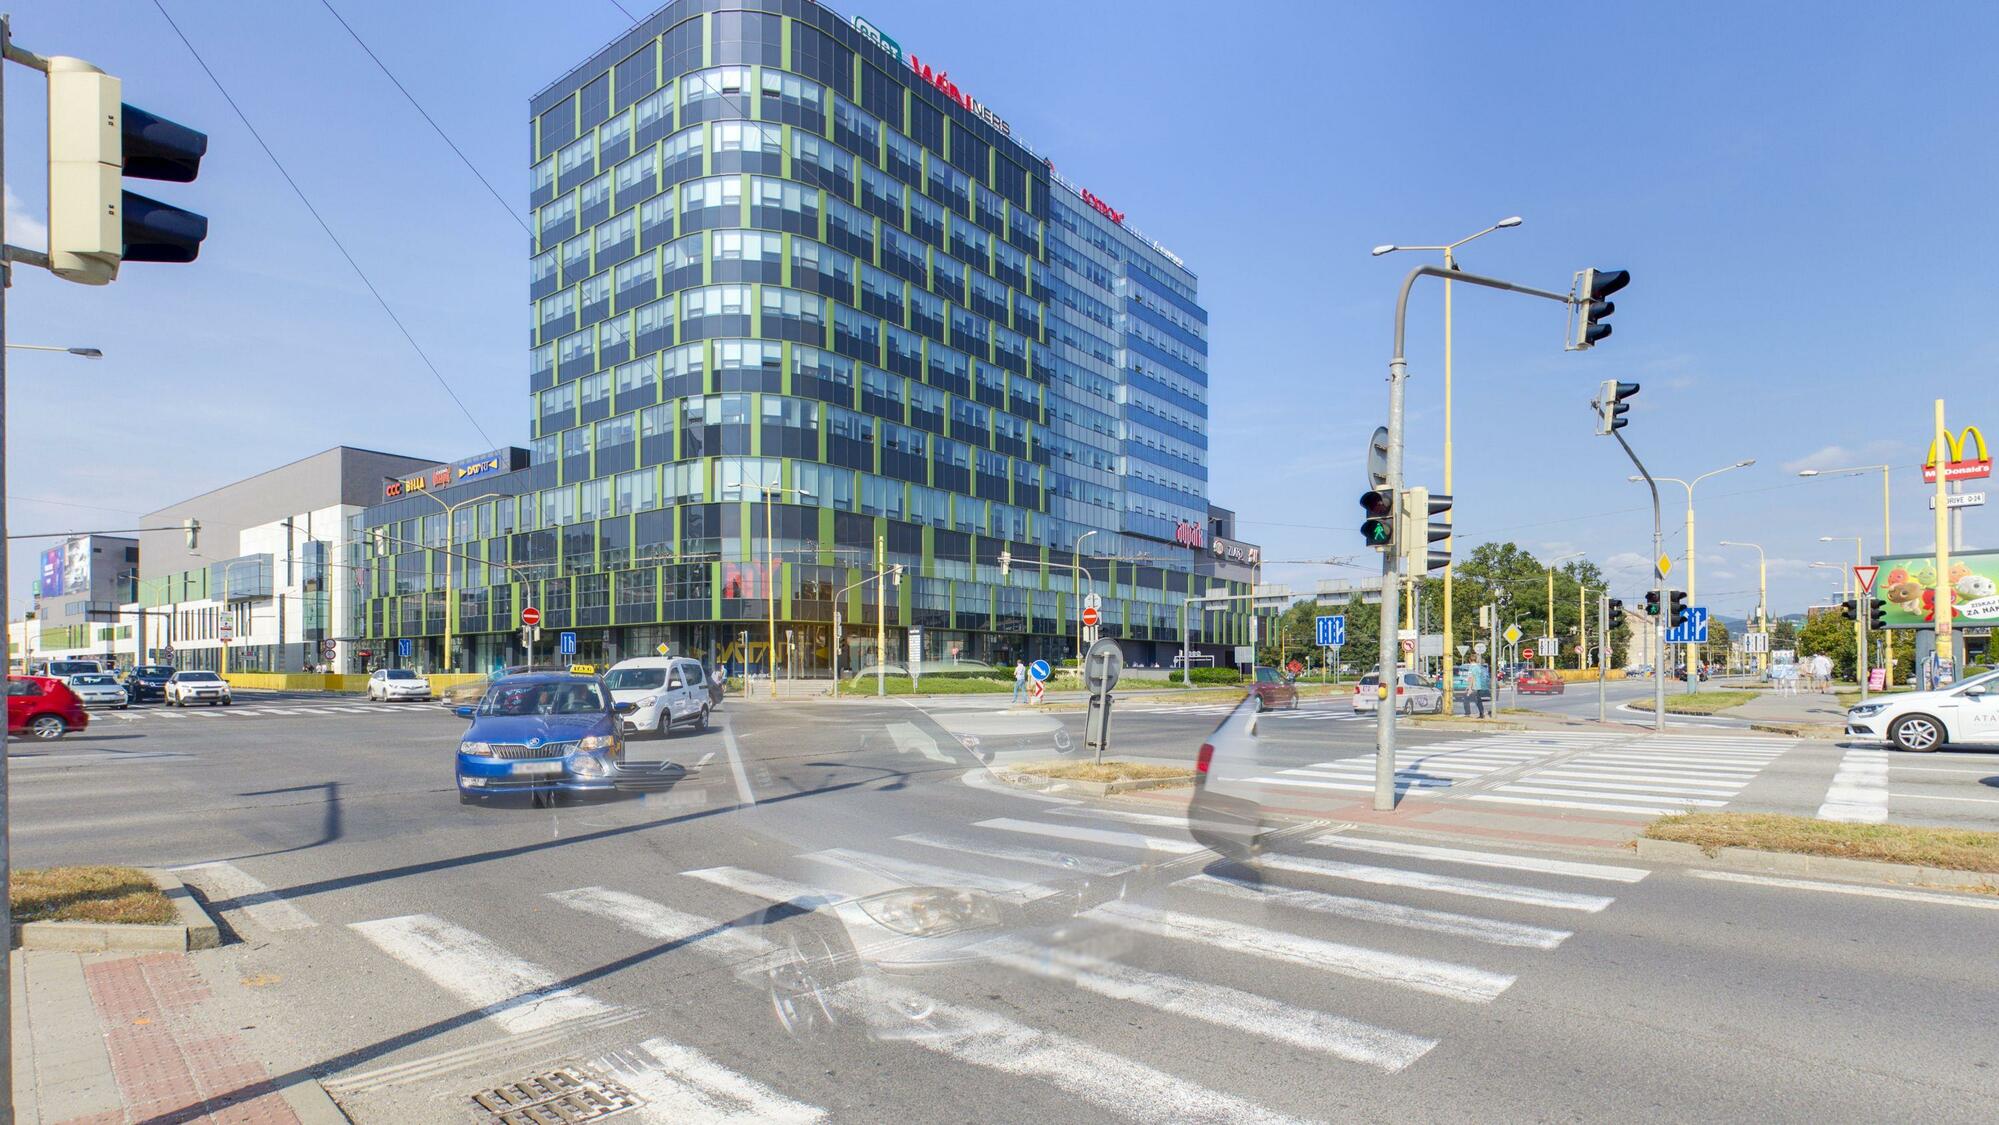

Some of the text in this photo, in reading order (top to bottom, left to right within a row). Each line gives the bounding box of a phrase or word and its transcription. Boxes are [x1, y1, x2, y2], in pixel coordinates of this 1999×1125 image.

[1925, 465, 1990, 478] MDonald's
[386, 482, 401, 497] CCC
[405, 477, 425, 492] BILLA
